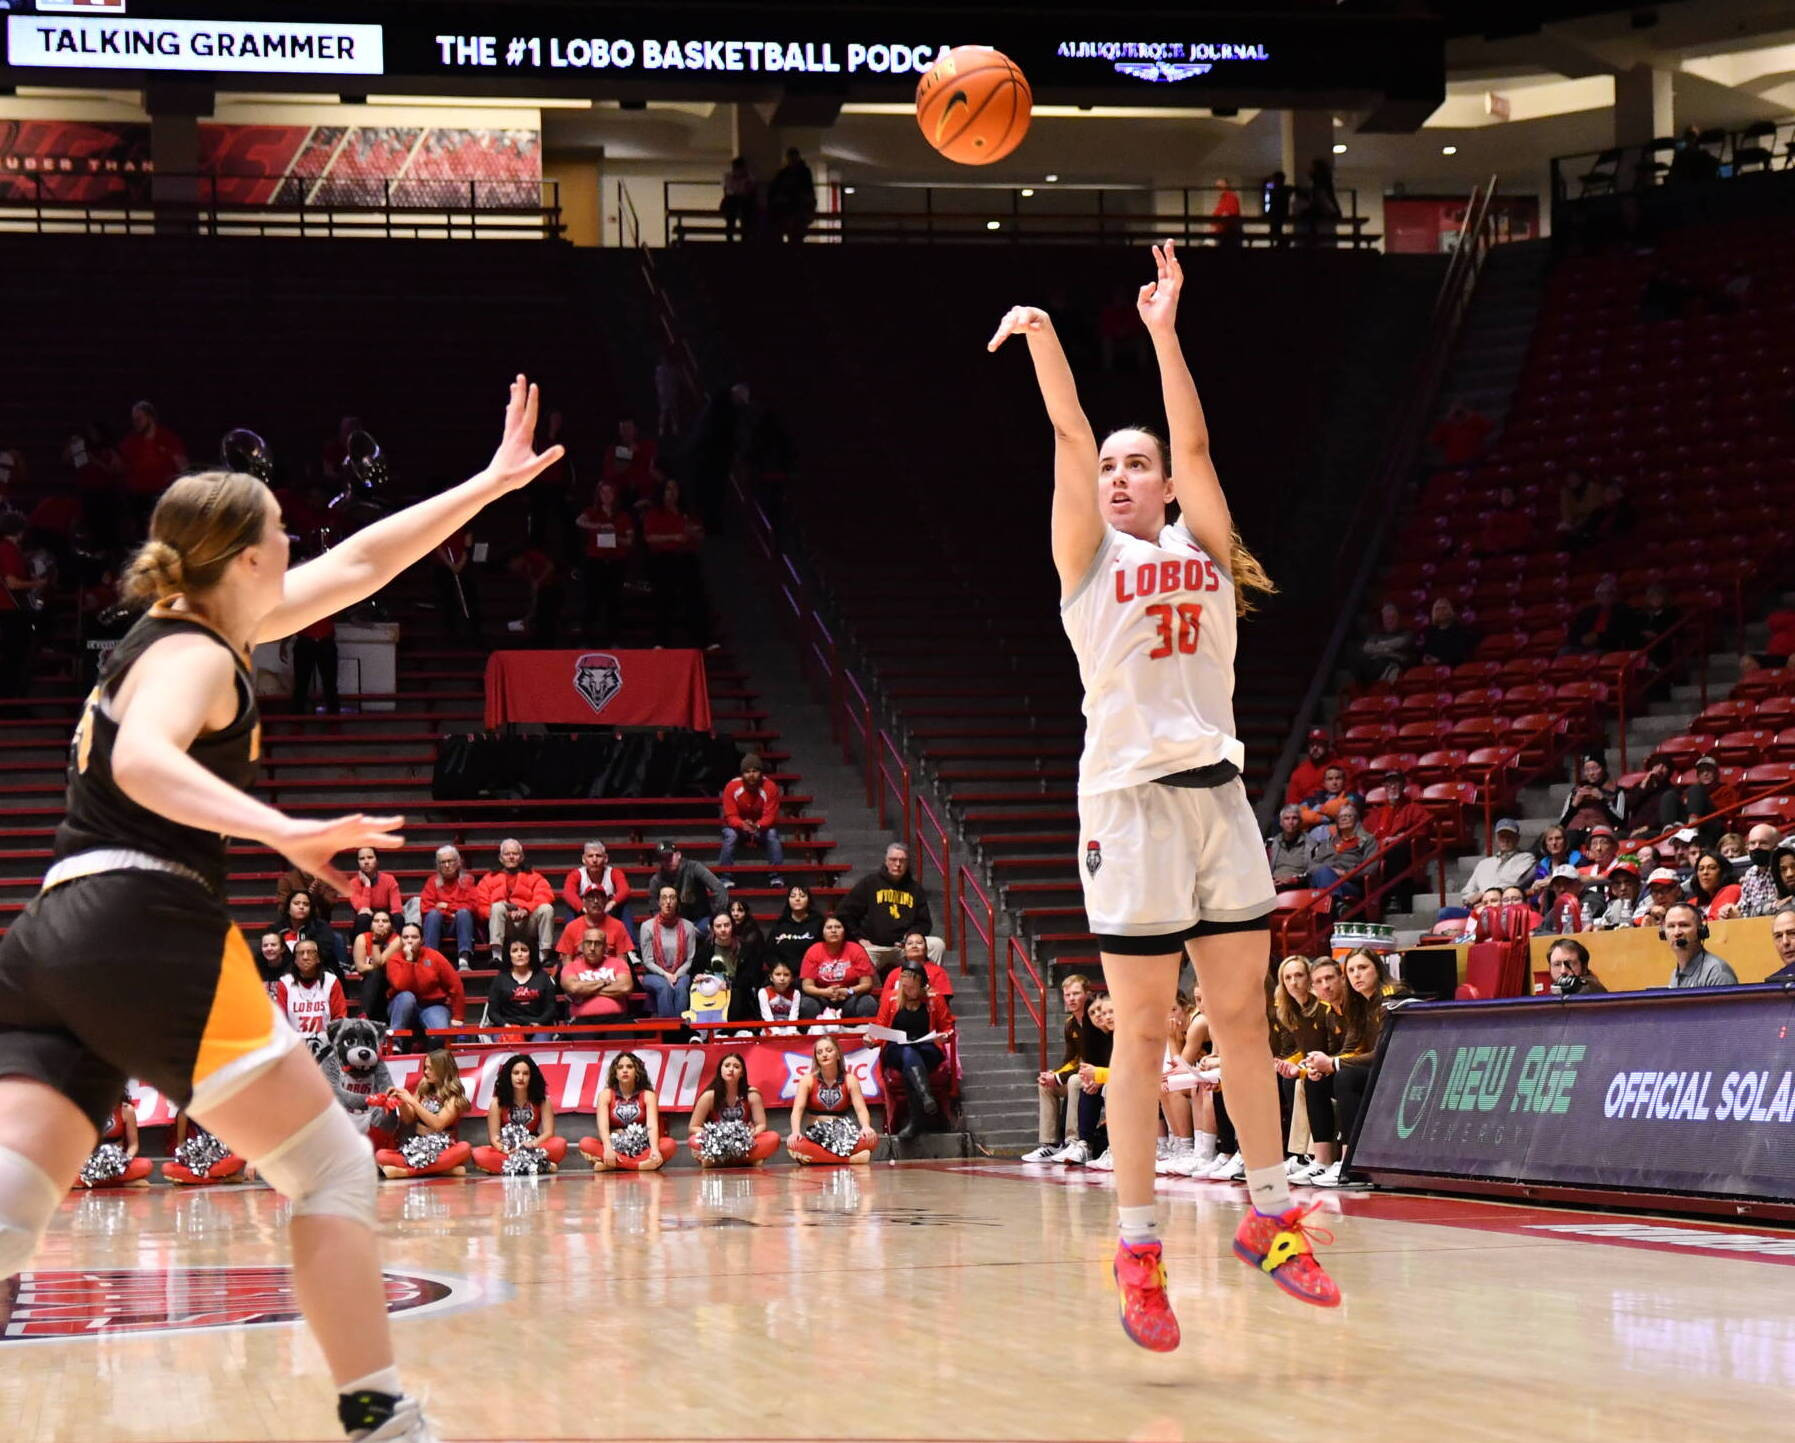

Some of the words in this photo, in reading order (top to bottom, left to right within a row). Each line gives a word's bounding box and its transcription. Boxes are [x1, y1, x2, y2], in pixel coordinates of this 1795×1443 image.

[37, 28, 181, 56] TALKING
[190, 32, 355, 60] GRAMMER
[435, 35, 497, 66] THE
[505, 37, 541, 67] #1
[550, 37, 635, 68] LOBO
[642, 40, 841, 72] BASKETBALL
[848, 43, 994, 74] PODCA
[1189, 43, 1270, 61] JOURNAL
[1115, 559, 1220, 604] LOBOS
[1145, 602, 1203, 661] 30
[876, 888, 915, 909] WYOMING
[293, 1000, 327, 1014] LOBOS
[1439, 1046, 1517, 1112] NEW
[1509, 1045, 1587, 1114] AGE
[1604, 1071, 1713, 1121] OFFICIAL
[1714, 1071, 1795, 1123] SOLA
